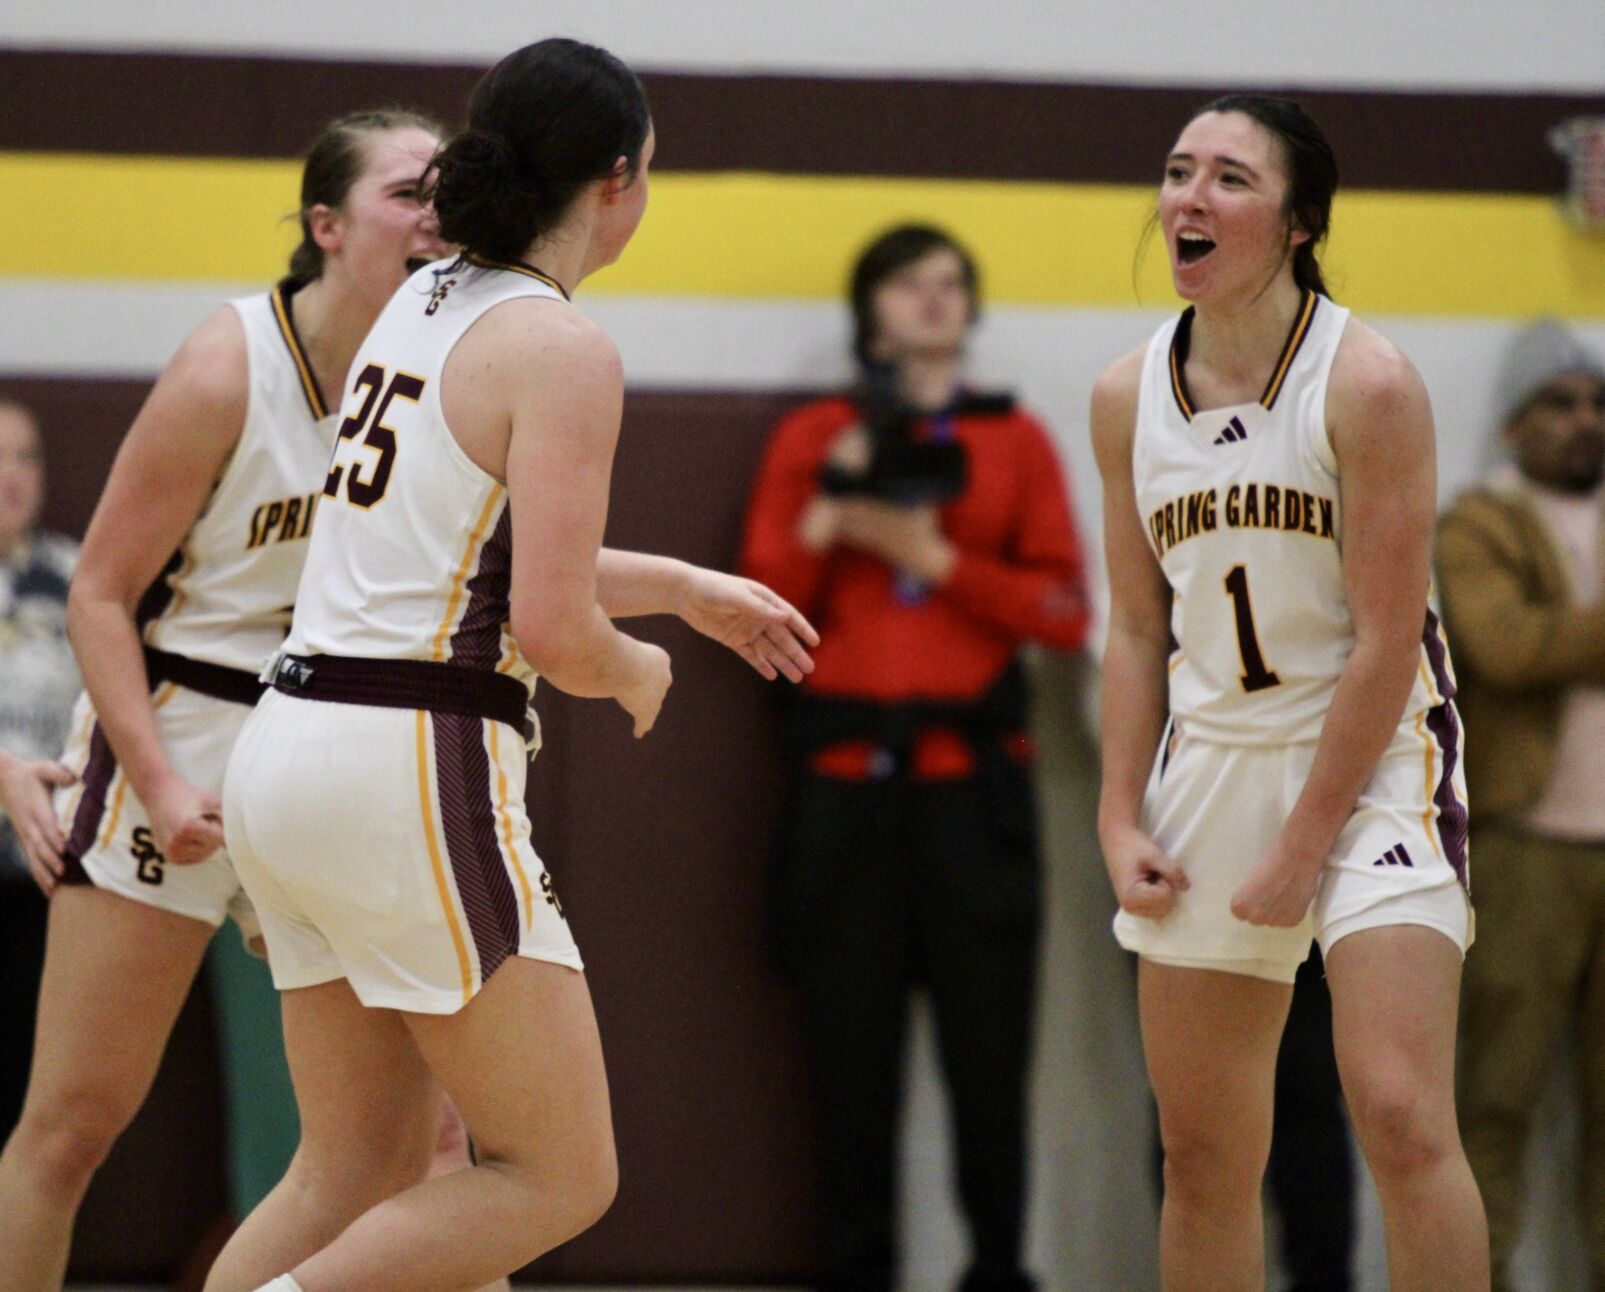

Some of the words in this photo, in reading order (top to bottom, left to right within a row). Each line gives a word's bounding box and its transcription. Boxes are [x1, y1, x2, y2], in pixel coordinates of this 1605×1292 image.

[321, 361, 428, 512] 25
[244, 492, 320, 551] SPRI
[1225, 481, 1336, 542] GARDEN
[1223, 562, 1283, 694] 1
[130, 825, 166, 887] SG
